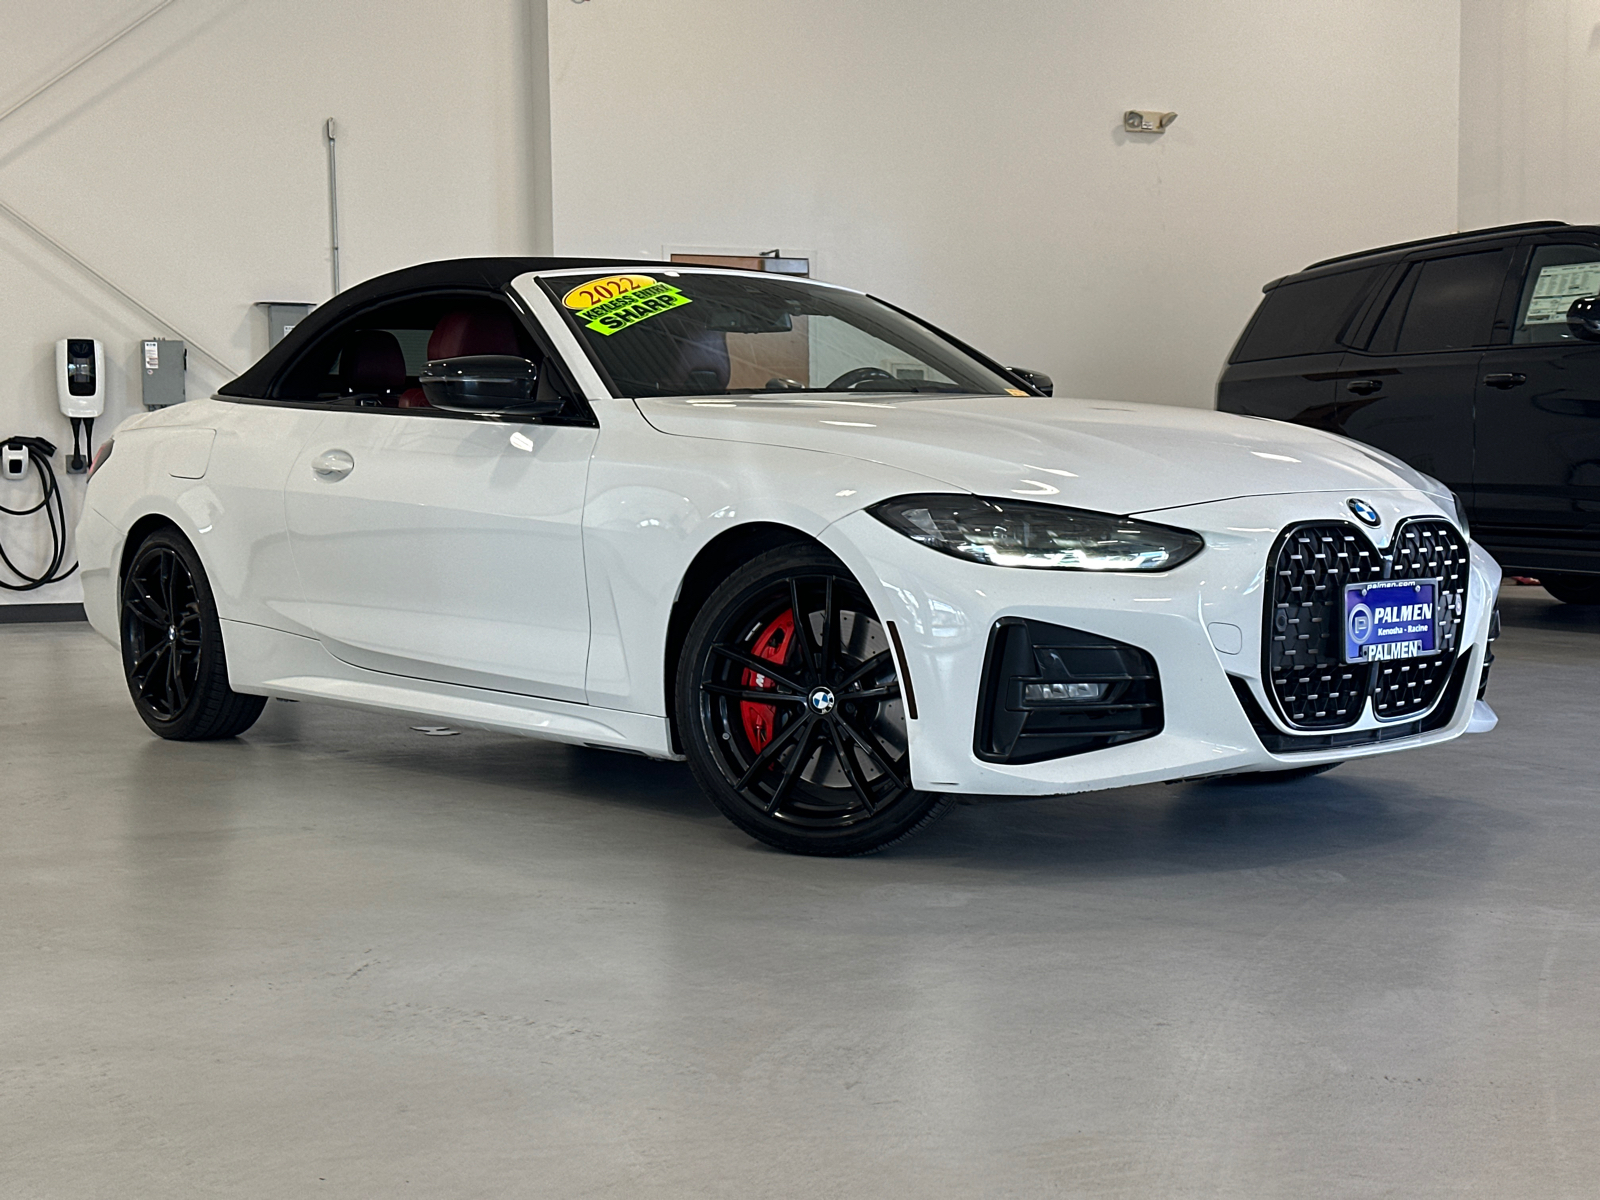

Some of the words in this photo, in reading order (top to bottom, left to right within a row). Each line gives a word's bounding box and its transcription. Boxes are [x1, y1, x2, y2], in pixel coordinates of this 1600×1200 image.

[579, 277, 641, 306] 2022
[583, 295, 638, 320] KEYLESS
[599, 294, 678, 330] SHARP
[1374, 603, 1433, 625] PALMEN
[1377, 627, 1403, 636] Kenosha
[1407, 624, 1428, 634] Racine
[1368, 641, 1418, 661] PALMEN
